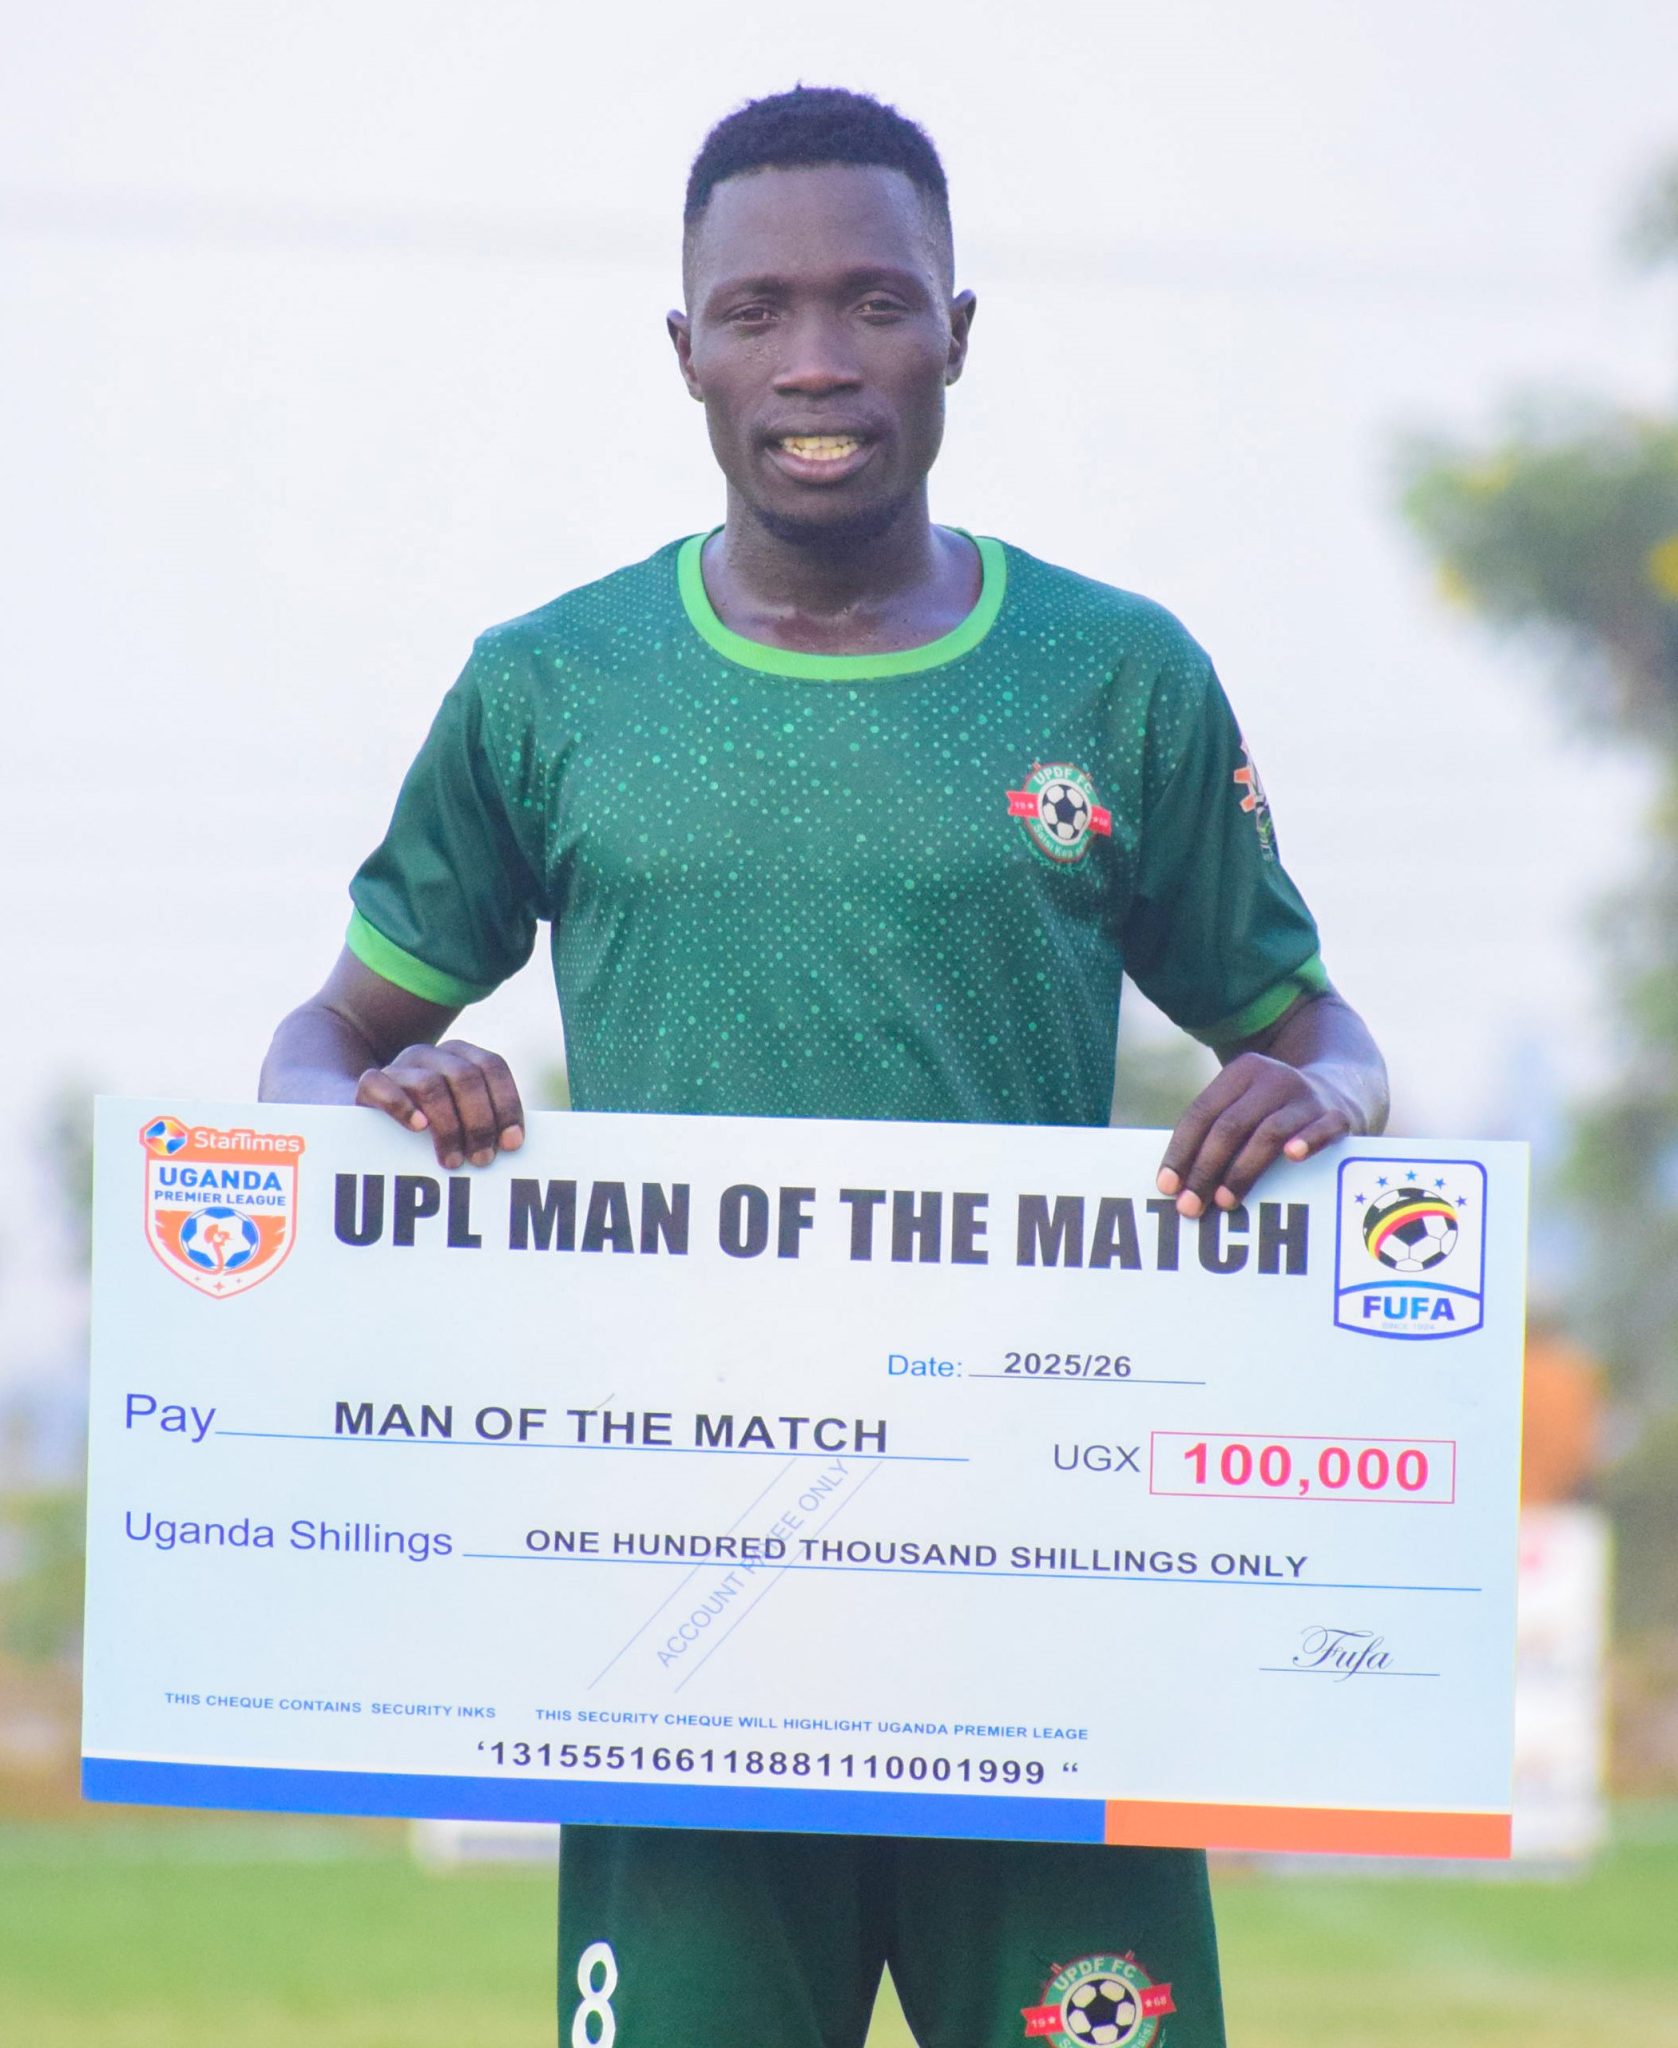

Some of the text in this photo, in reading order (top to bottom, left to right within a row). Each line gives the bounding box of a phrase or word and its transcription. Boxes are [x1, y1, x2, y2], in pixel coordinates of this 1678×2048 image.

[1034, 766, 1073, 785] UPDF
[194, 1131, 300, 1152] StarTimes
[159, 1166, 282, 1191] UGANDA
[154, 1190, 286, 1206] PREMIER LEAGUE
[335, 1174, 1310, 1276] UPL MAN OF THE MATCH
[1363, 1296, 1456, 1321] FUFA
[888, 1351, 1132, 1378] Date: 2025/26
[126, 1394, 887, 1453] Pay MAN OF THE MATCH
[1054, 1442, 1429, 1496] UGX 100,000
[125, 1511, 1307, 1578] Uganda Shillings ONE HUNDRED THOUSAND SHILLINGS ONLY
[656, 1571, 745, 1668] ACCOUNT
[798, 1457, 849, 1512] ONLY
[1293, 1626, 1394, 1682] Fufa
[165, 1693, 496, 1719] THIS CHEQUE CONTAINS SECURITY INKS
[535, 1708, 1089, 1741] THIS SECURITY CHEQUE WILL HIGHLIGHT UGANDA PREMIER LEAGE
[1053, 1957, 1138, 1991] UPDF FC
[571, 1941, 618, 2048] 8
